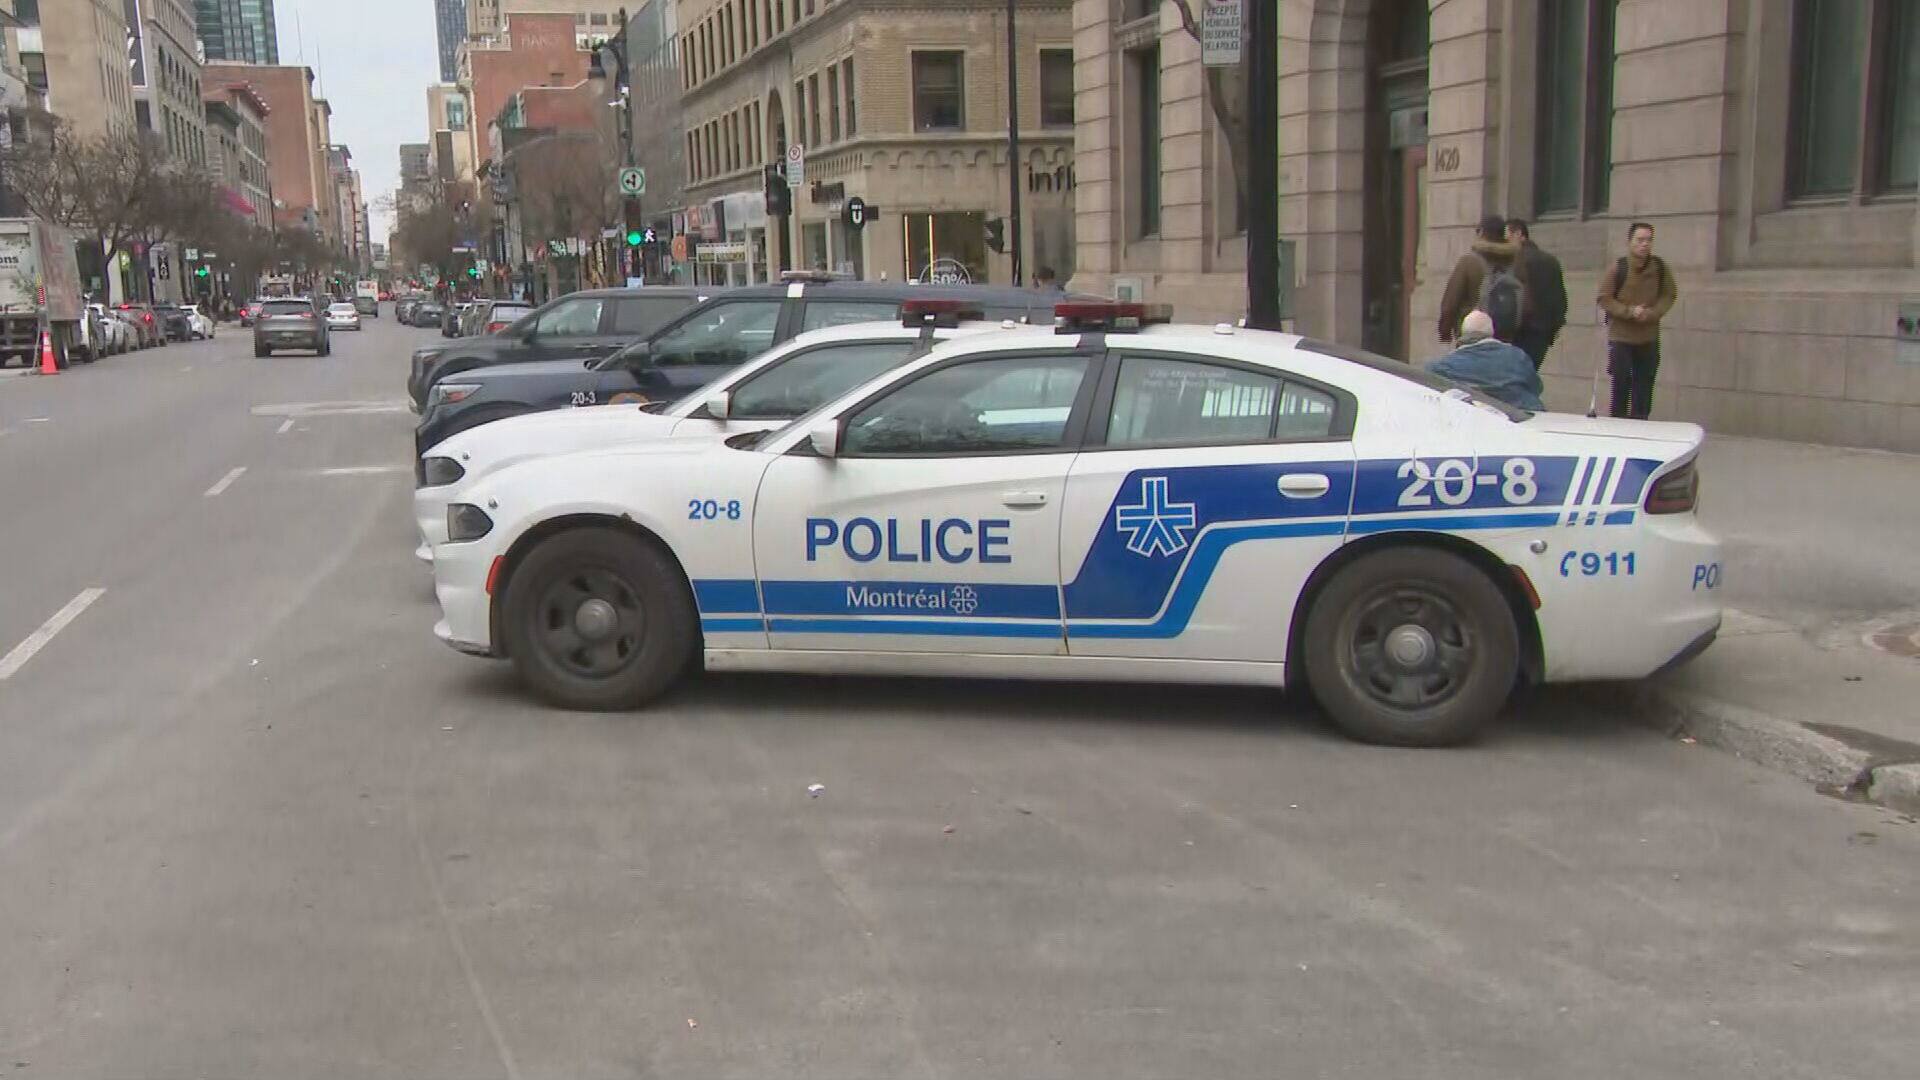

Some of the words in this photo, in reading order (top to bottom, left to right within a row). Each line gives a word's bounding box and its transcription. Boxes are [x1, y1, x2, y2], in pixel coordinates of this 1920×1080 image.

[1435, 147, 1460, 172] 1420
[571, 391, 596, 404] 20-3
[1397, 457, 1538, 507] 20-8
[688, 499, 741, 521] 20-8
[806, 516, 1012, 564] POLICE
[1580, 551, 1635, 576] 911
[1692, 562, 1720, 592] PO
[846, 586, 946, 610] Montréal
